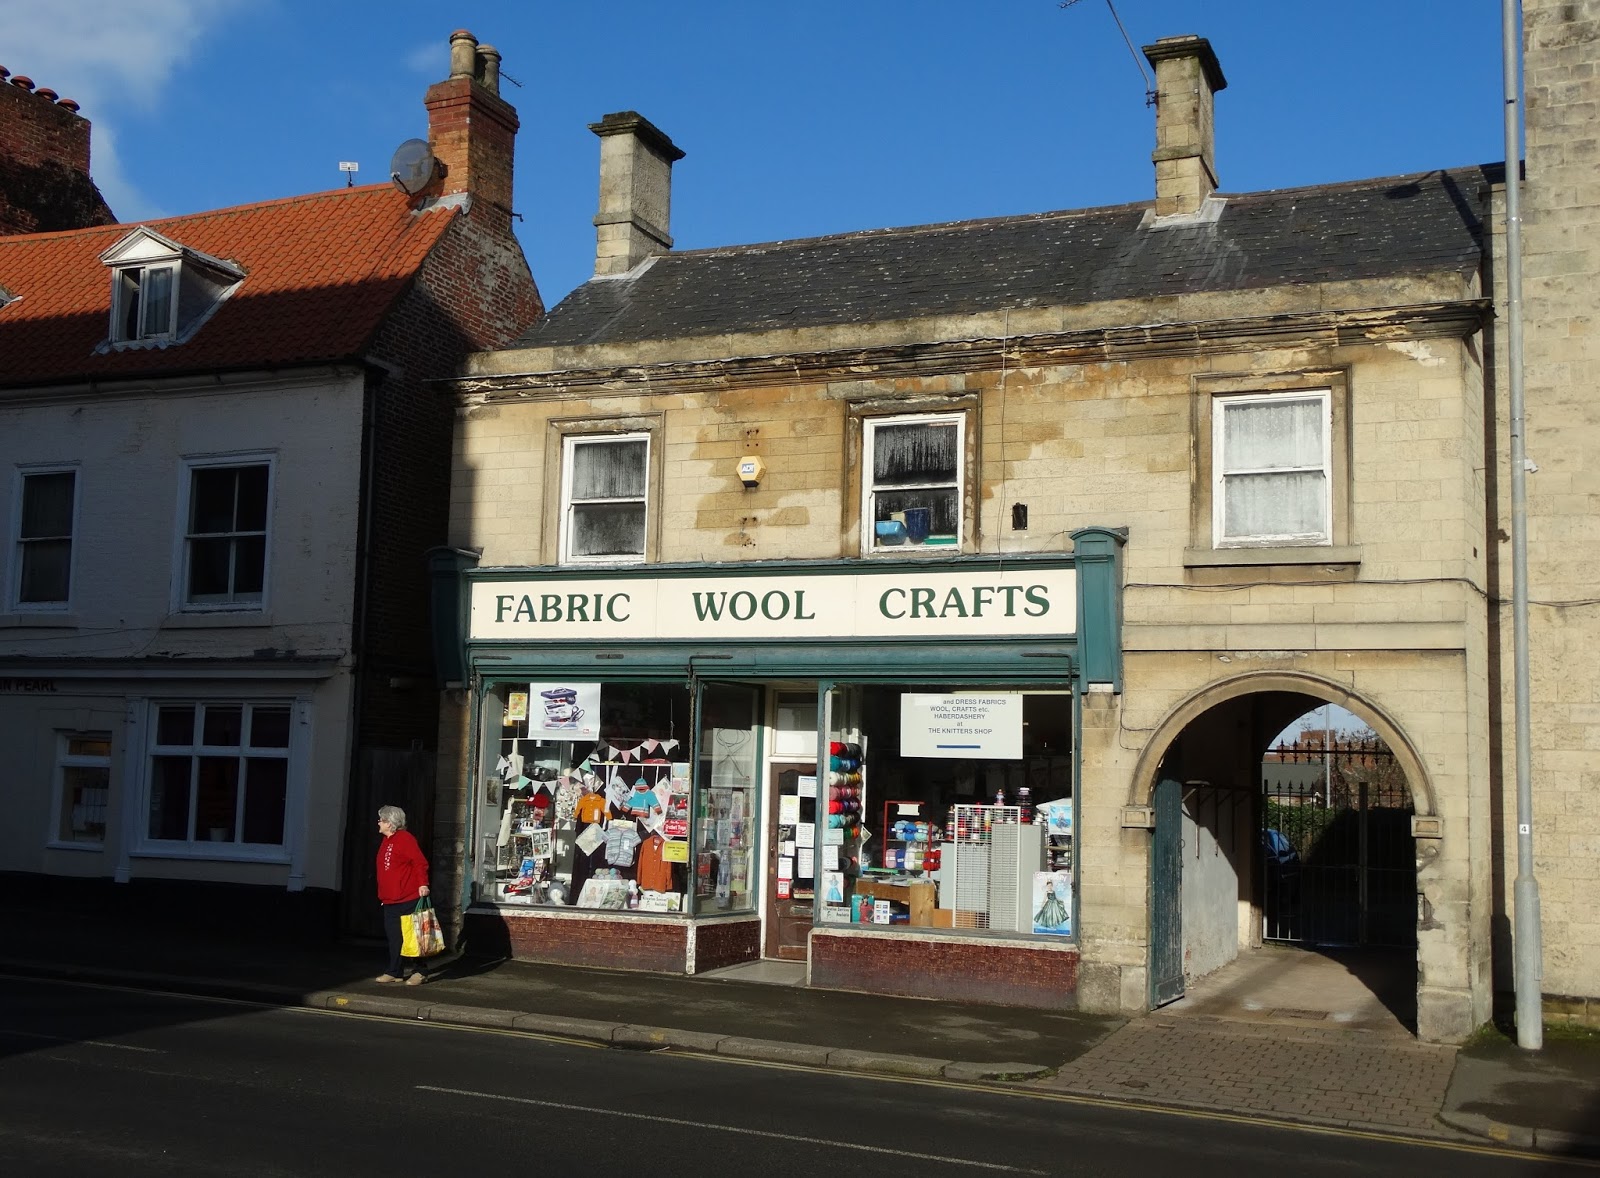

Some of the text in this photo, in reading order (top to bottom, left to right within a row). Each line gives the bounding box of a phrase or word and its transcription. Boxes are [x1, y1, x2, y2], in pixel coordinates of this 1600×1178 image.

[494, 585, 1050, 622] FABRIC WOOL CRAFTS
[16, 678, 58, 691] PEARL
